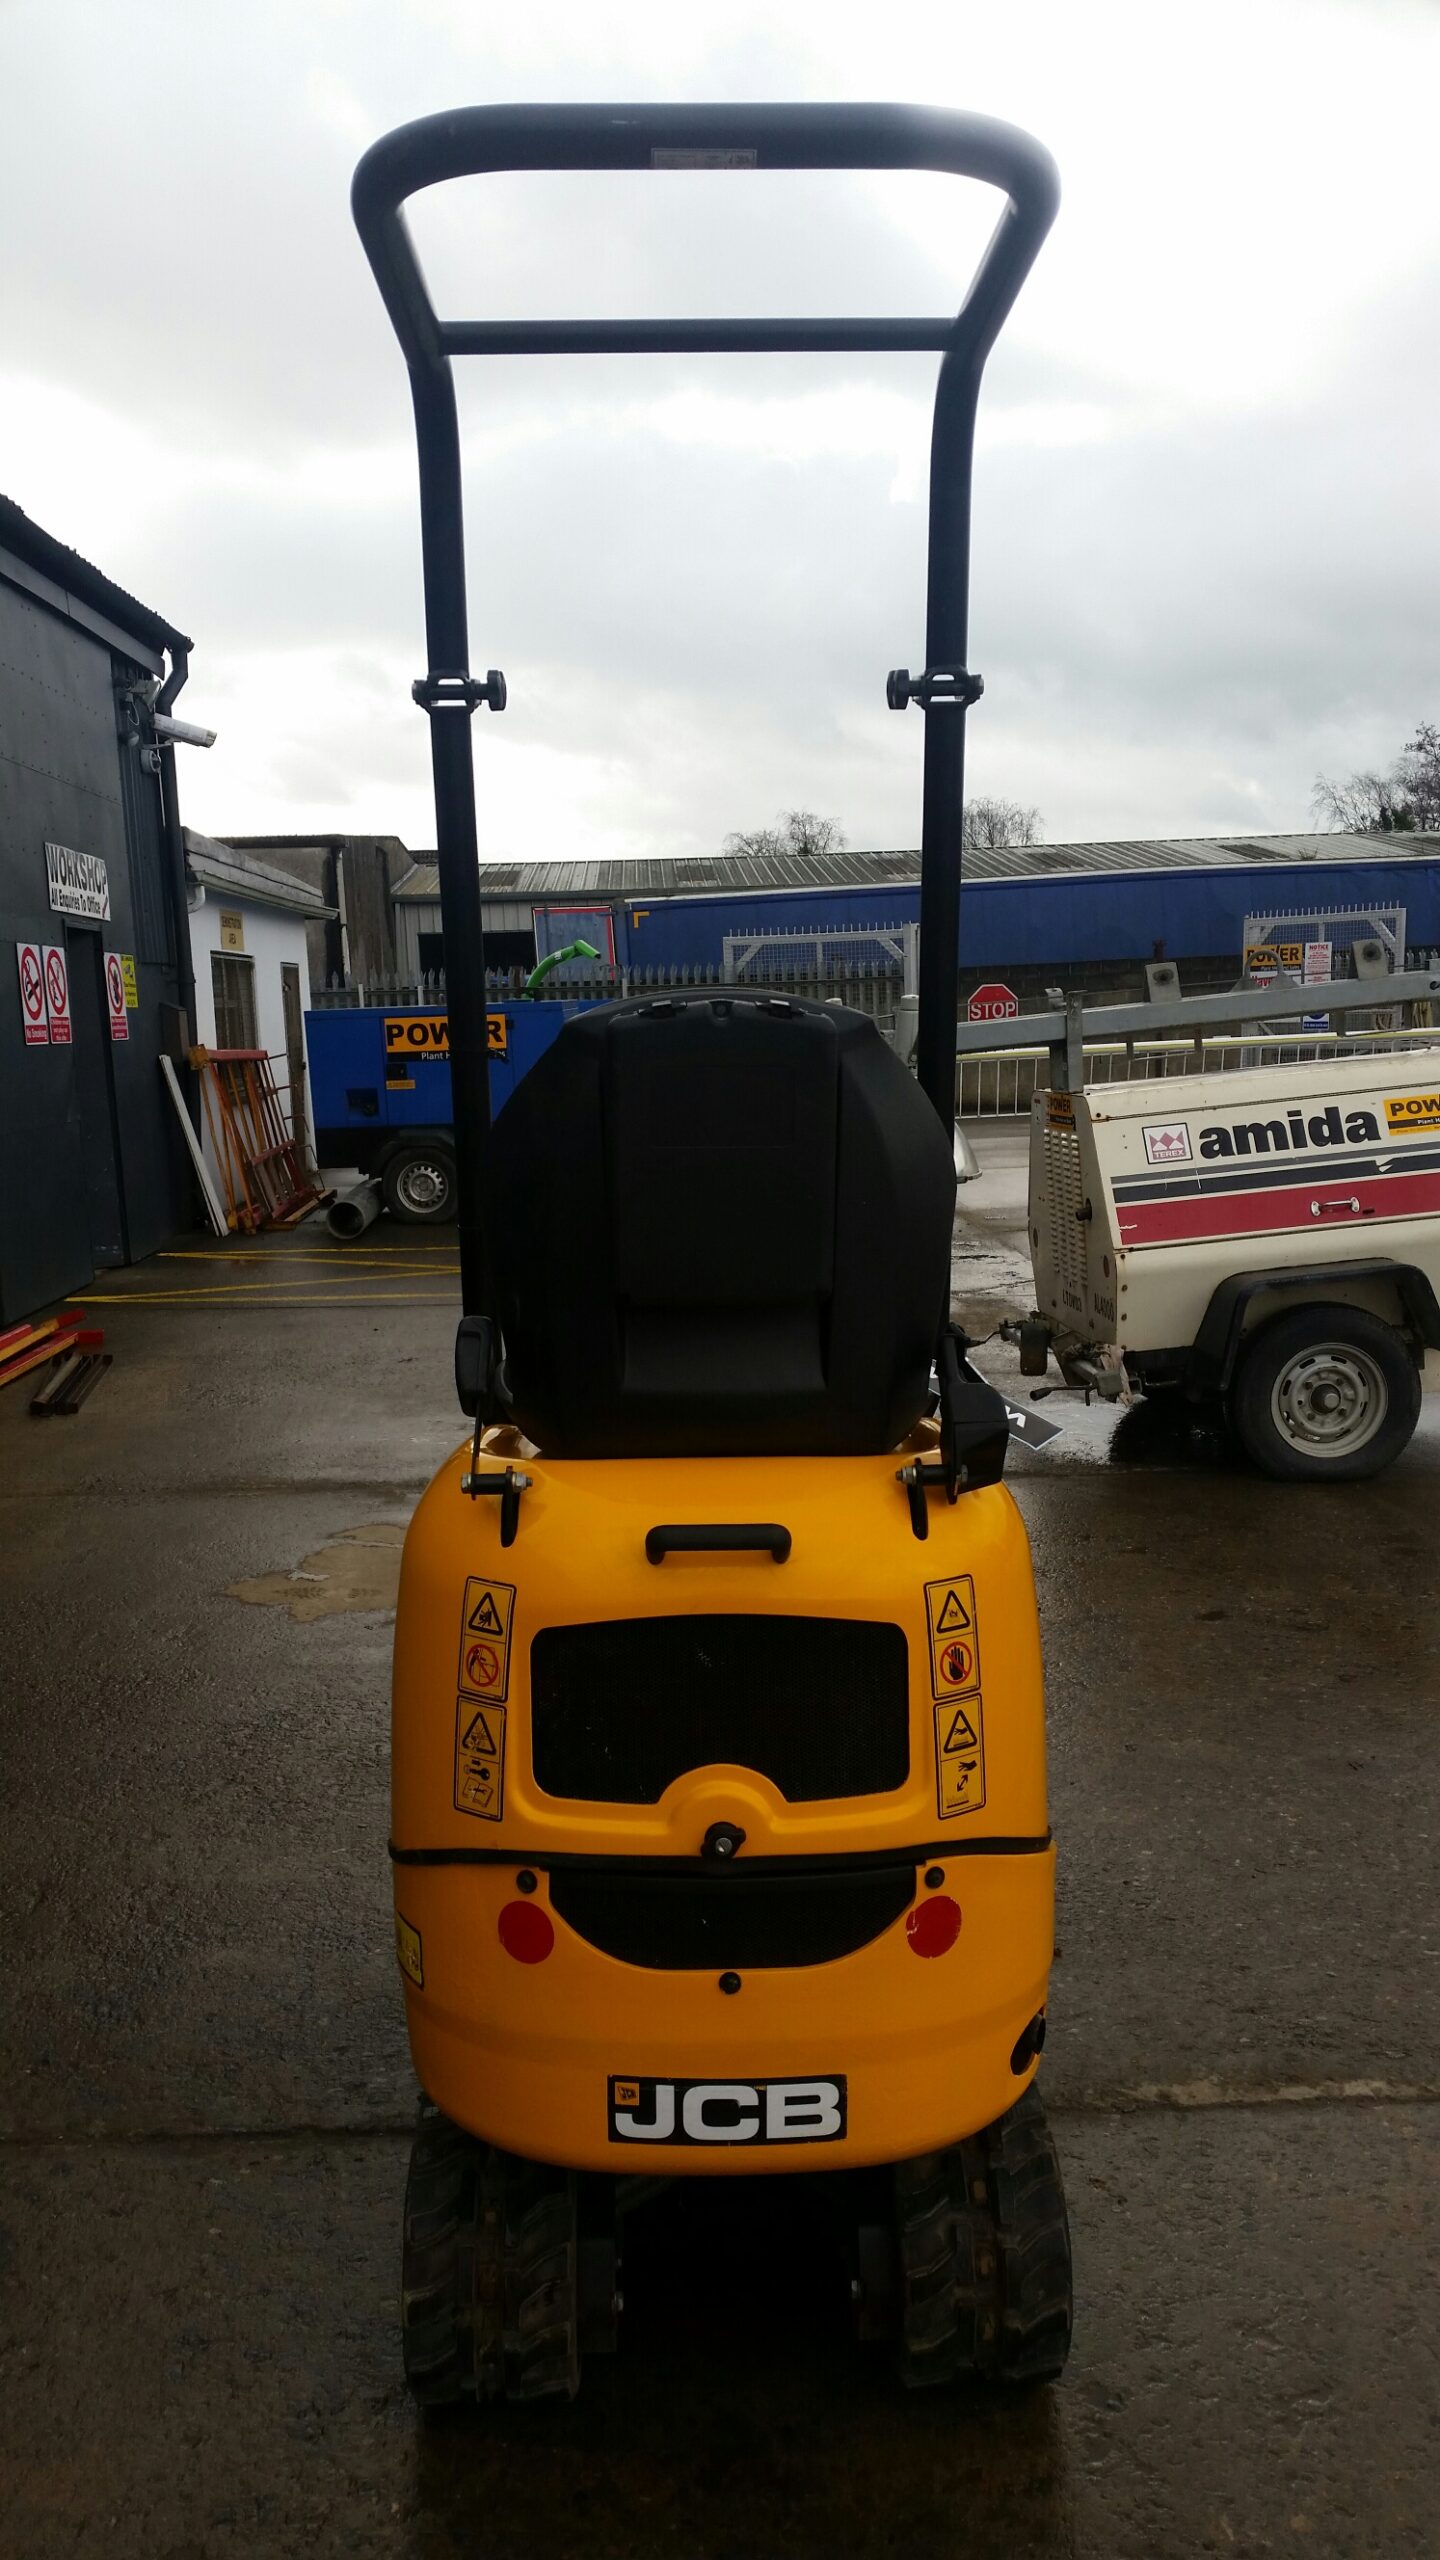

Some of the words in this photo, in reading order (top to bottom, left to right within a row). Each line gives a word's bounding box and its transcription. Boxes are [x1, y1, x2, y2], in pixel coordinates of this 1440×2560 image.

[46, 845, 106, 895] WORKSHOP
[51, 887, 59, 906] All
[59, 888, 80, 911] Enquiries
[80, 893, 87, 912] To
[87, 895, 101, 914] Office
[971, 1002, 1016, 1019] STOP
[26, 1028, 32, 1038] No
[32, 1028, 48, 1039] Smoking
[386, 1021, 503, 1046] POWR
[421, 1051, 443, 1060] Plant
[1049, 1096, 1071, 1113] POWER
[1199, 1106, 1381, 1159] amida
[1153, 1149, 1185, 1158] TEREX
[615, 2082, 842, 2141] JCB
